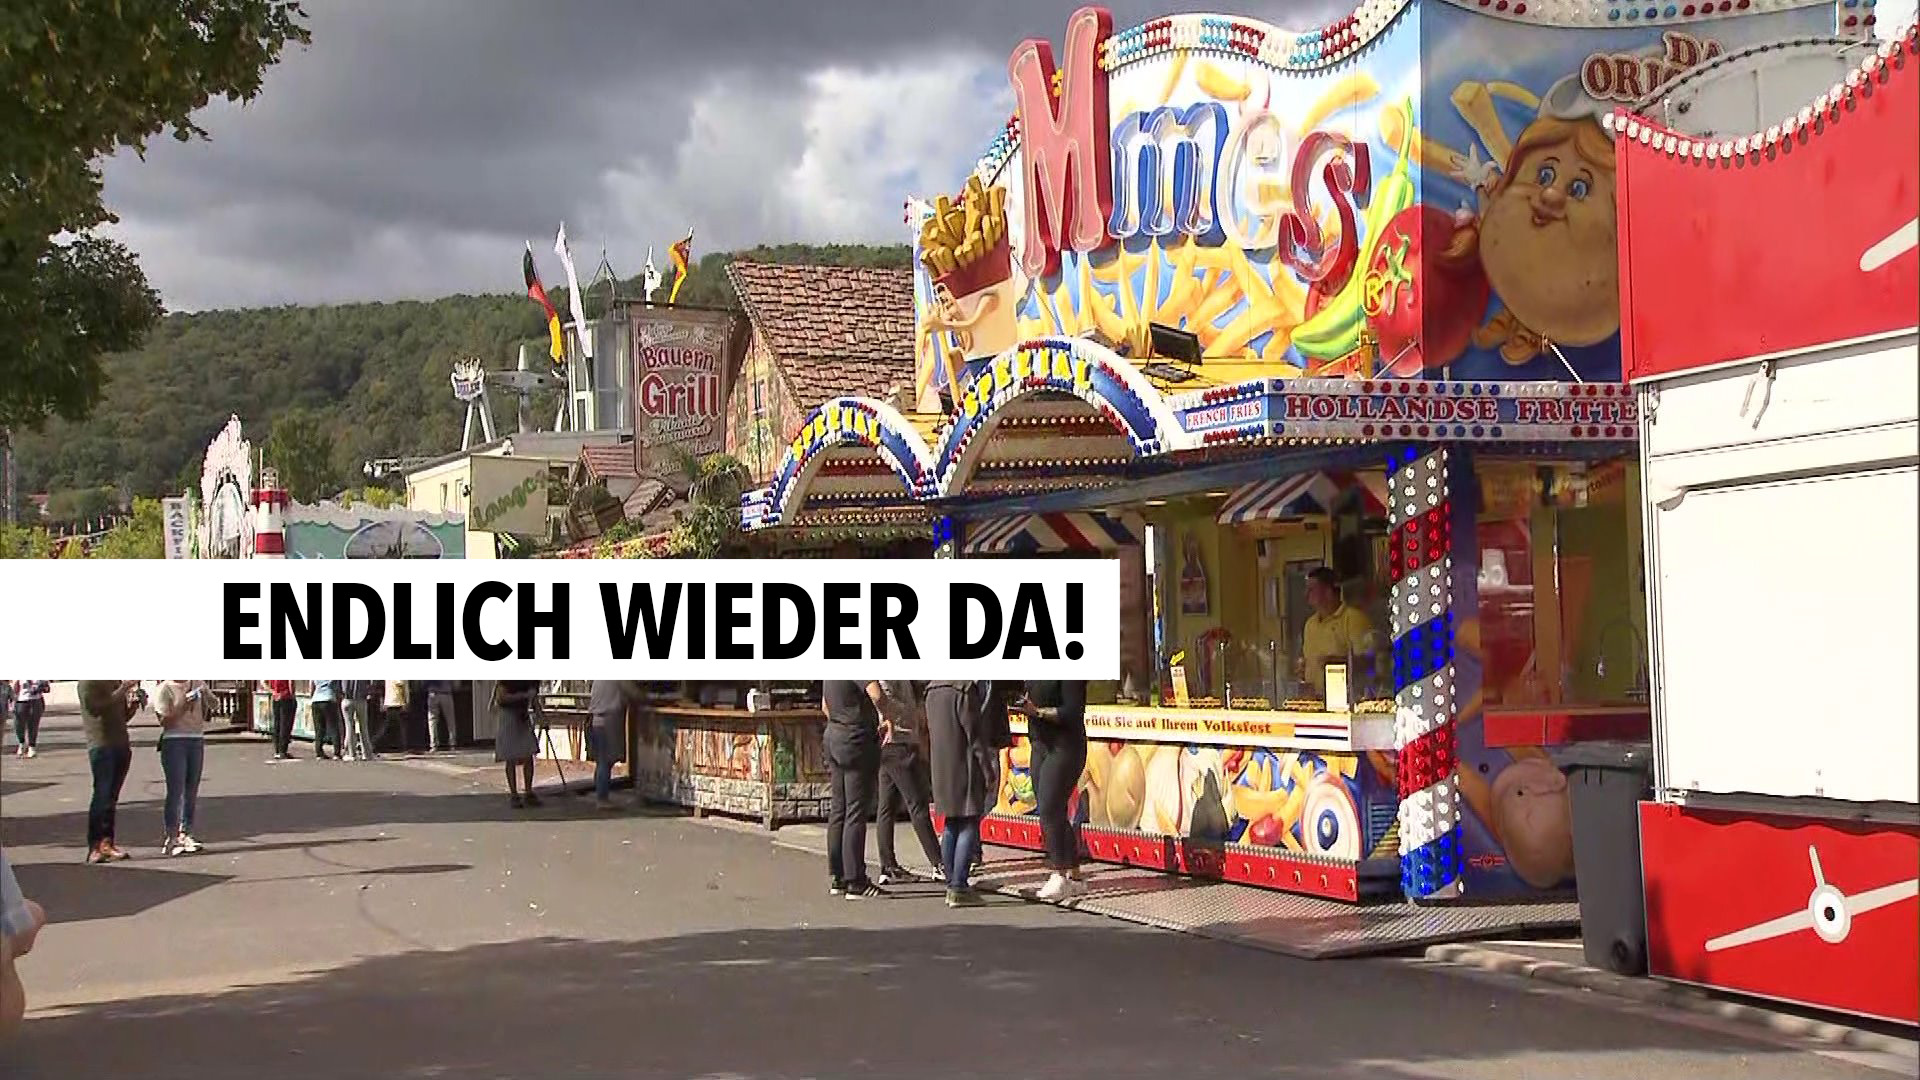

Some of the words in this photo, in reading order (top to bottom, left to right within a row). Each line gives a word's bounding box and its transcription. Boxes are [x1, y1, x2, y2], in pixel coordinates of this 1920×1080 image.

[640, 345, 716, 372] Bauern
[640, 371, 719, 420] Grill
[963, 348, 1092, 419] SPEZIAL
[1186, 407, 1227, 429] FRENCH
[1229, 401, 1261, 421] FRIES
[1285, 396, 1498, 422] HOLLANDSE
[1516, 399, 1638, 423] FRITTE
[792, 405, 881, 461] SPEZIAL
[1085, 715, 1111, 727] rüßt
[1114, 716, 1133, 728] Sie
[1136, 717, 1157, 729] auf
[1161, 718, 1198, 731] Ihrem
[1203, 719, 1272, 734] Volksfest
